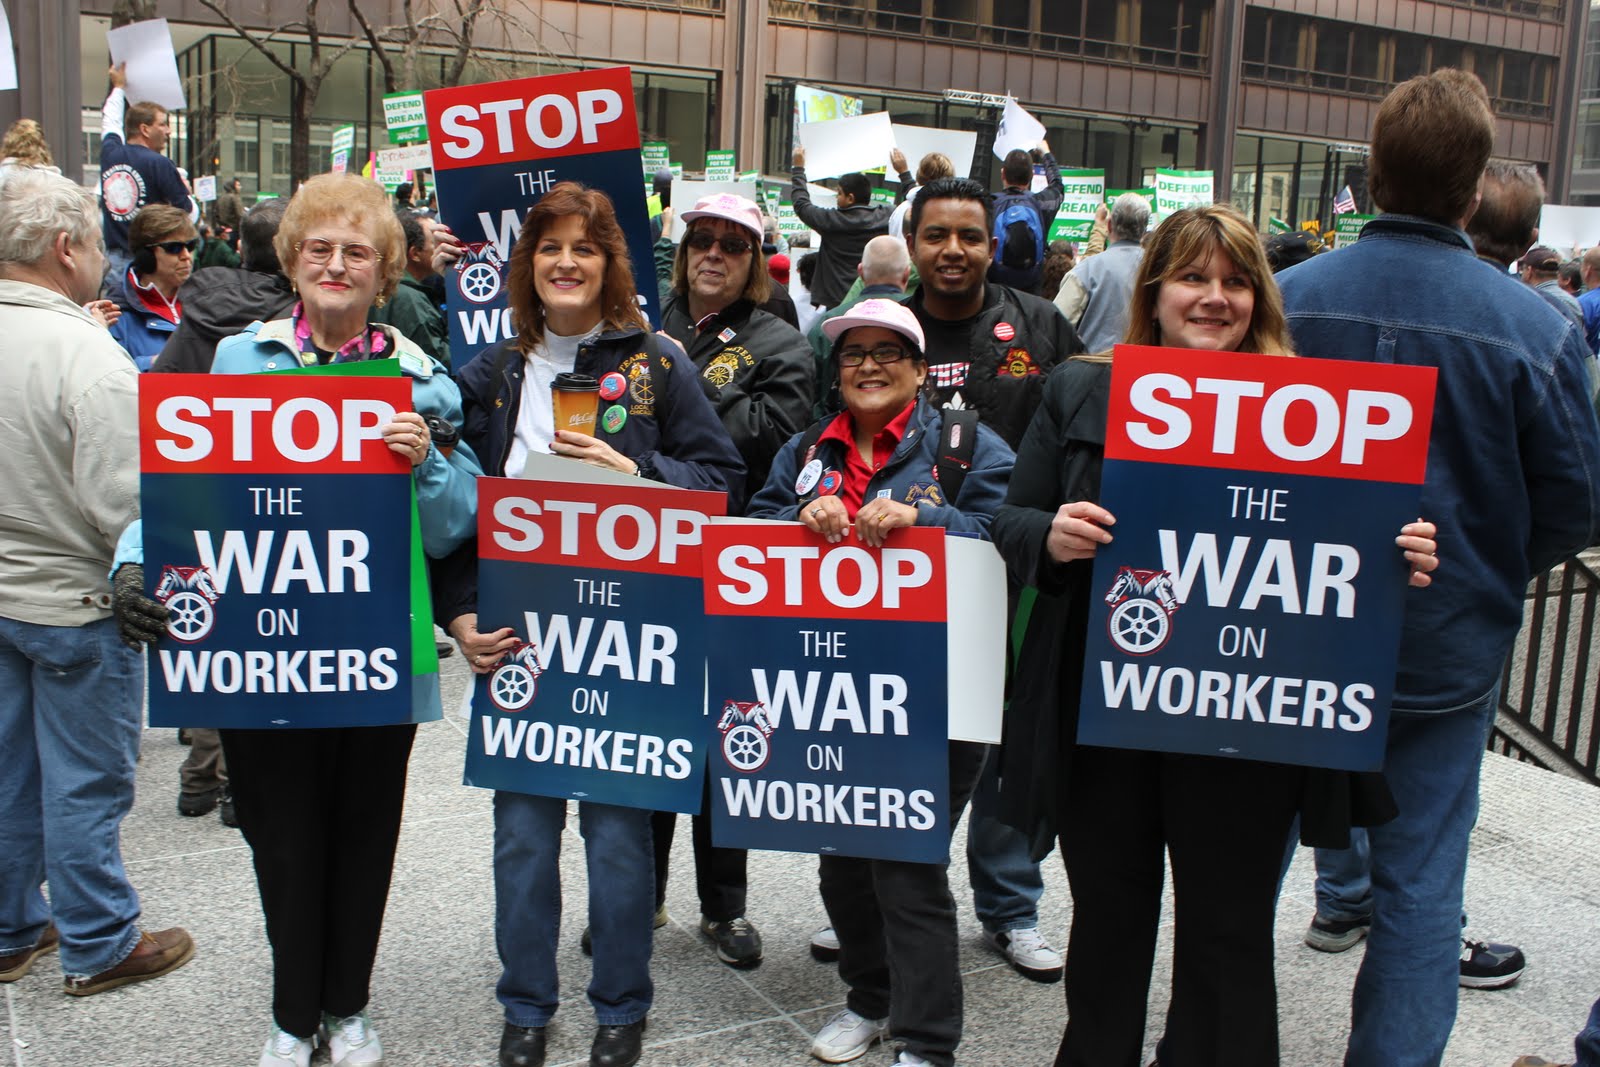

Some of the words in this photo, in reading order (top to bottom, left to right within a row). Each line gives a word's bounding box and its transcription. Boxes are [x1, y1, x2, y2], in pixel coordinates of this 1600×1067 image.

[385, 100, 421, 111] DEFEND
[387, 113, 424, 124] DREAM
[440, 88, 623, 159] STOP
[514, 169, 556, 196] THE
[1063, 184, 1103, 194] EFEND
[1158, 181, 1211, 193] DEFEND
[1060, 203, 1098, 213] REAM
[1339, 217, 1363, 225] STAND
[1338, 234, 1359, 242] MIDD
[155, 395, 397, 464] STOP
[1125, 372, 1413, 465] STOP
[248, 487, 303, 515] THE
[1226, 485, 1289, 522] THE
[492, 496, 711, 565] STOP
[193, 529, 371, 594] WAR
[717, 544, 933, 609] STOP
[1158, 528, 1361, 618] WAR
[573, 578, 622, 607] THE
[256, 608, 299, 636] ON
[524, 611, 679, 686] WAR
[799, 630, 847, 658] THE
[1217, 624, 1267, 659] ON
[159, 646, 399, 694] WORKERS
[571, 687, 609, 717] ON
[751, 668, 910, 735] WAR
[1100, 660, 1376, 733] WORKERS
[481, 715, 693, 780] WORKERS
[806, 744, 844, 772] ON
[720, 777, 936, 831] WORKERS
